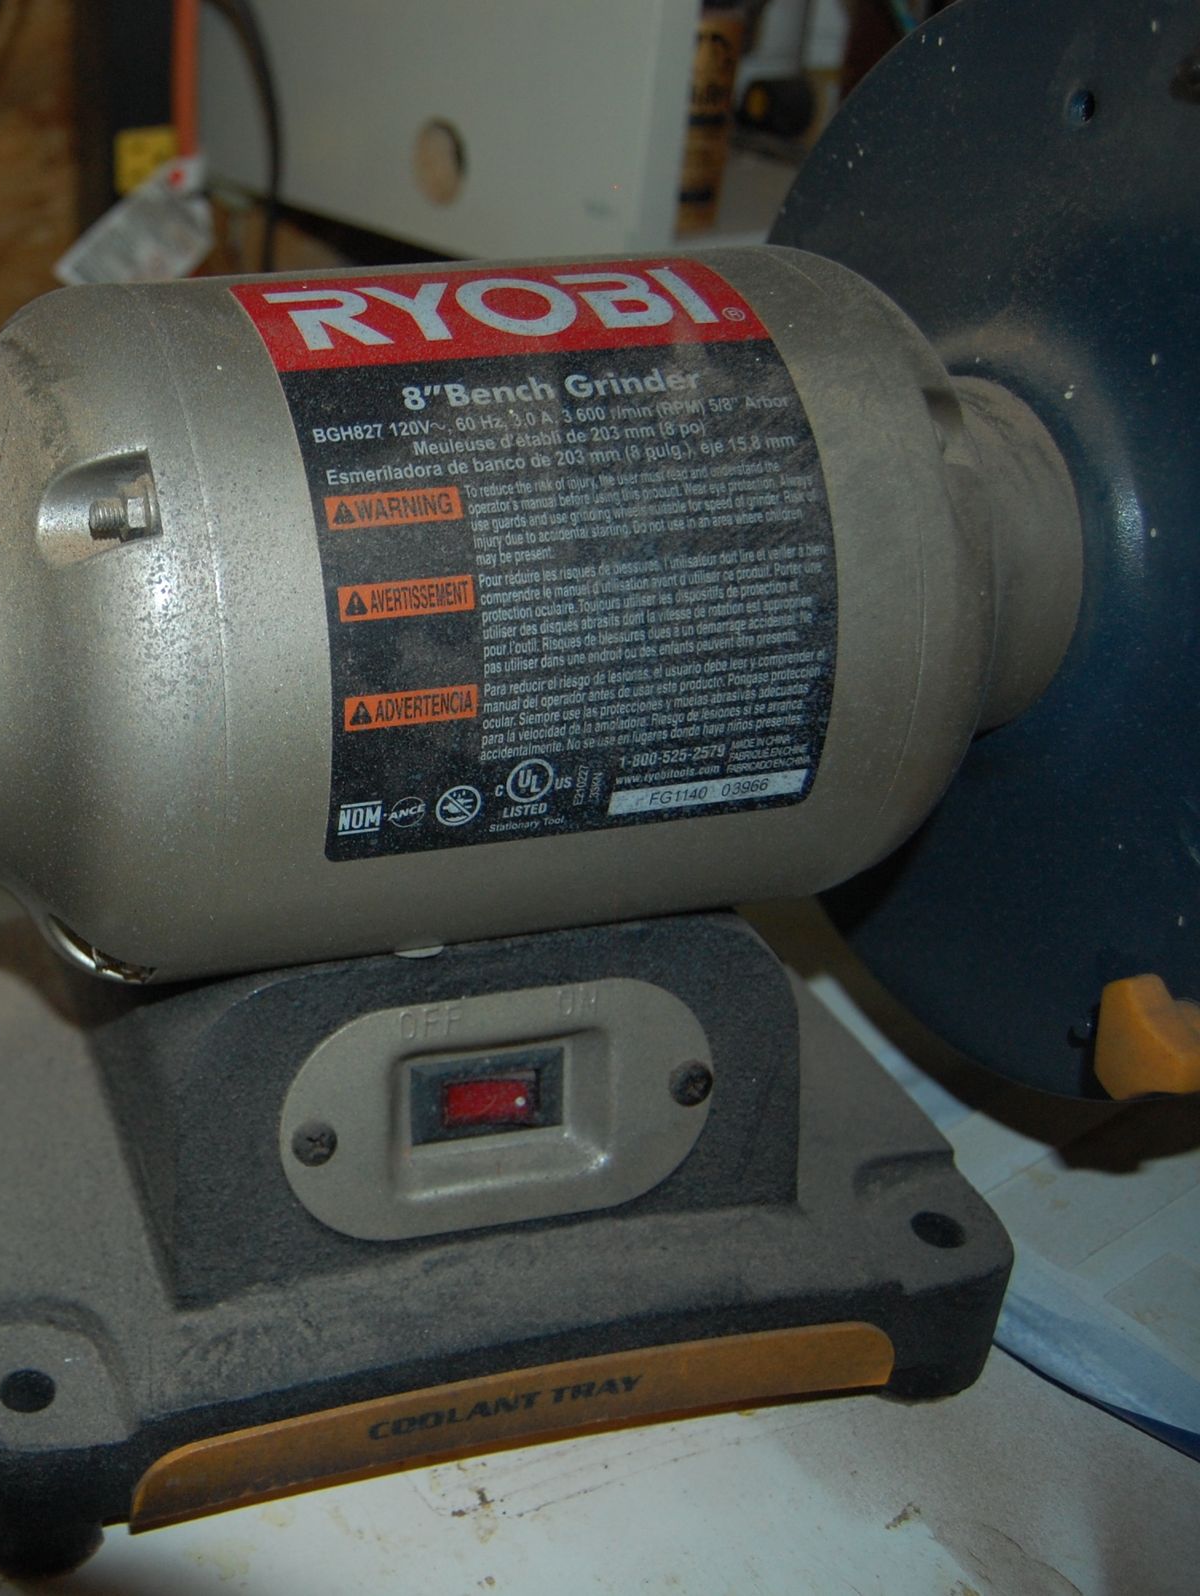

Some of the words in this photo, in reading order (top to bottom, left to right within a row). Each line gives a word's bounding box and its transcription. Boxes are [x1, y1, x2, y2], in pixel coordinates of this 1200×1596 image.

[262, 268, 719, 351] RYOBI
[564, 369, 700, 398] Grinder
[312, 425, 382, 444] BGH827
[455, 417, 475, 431] 60
[511, 412, 535, 427] 3.0
[576, 407, 605, 422] 600
[745, 394, 790, 409] Arbor
[413, 439, 496, 456] Meuleuse
[501, 431, 561, 449] d'établi
[566, 429, 587, 443] de
[589, 426, 620, 441] 203
[624, 427, 654, 438] mm
[659, 422, 675, 440] (8
[680, 419, 705, 438] po)
[326, 464, 443, 485] Esmeriladora
[447, 461, 469, 474] de
[472, 459, 526, 472] banco
[531, 454, 552, 468] de
[555, 450, 586, 466] 203
[589, 451, 622, 463] mm
[624, 446, 641, 464] (8
[701, 440, 724, 458] eje
[765, 437, 797, 449] mm
[464, 486, 477, 498] To
[480, 483, 513, 497] reduce
[516, 481, 532, 493] the
[535, 478, 553, 492] risk
[555, 477, 565, 490] of
[354, 493, 453, 522] WARNING
[521, 496, 557, 510] manual
[559, 494, 589, 506] before
[471, 520, 489, 531] use
[492, 516, 526, 533] guards
[529, 513, 548, 526] and
[551, 513, 567, 524] use
[473, 536, 502, 552] injury
[505, 534, 524, 545] due
[526, 532, 537, 543] to
[649, 519, 664, 532] not
[687, 517, 696, 529] in
[698, 517, 710, 528] an
[712, 515, 733, 526] area
[476, 554, 498, 567] may
[500, 552, 513, 563] be
[479, 574, 502, 587] Pour
[543, 569, 557, 581] les
[560, 567, 595, 582] risques
[370, 581, 468, 613] AVERTISSEMENT
[481, 588, 540, 607] comprendre
[542, 586, 552, 599] le
[555, 582, 589, 598] manuel
[482, 606, 532, 626] protection
[534, 602, 577, 617] oculaire.
[578, 598, 621, 615] Toujours
[483, 626, 517, 640] utiliser
[520, 623, 538, 636] des
[540, 620, 579, 636] disques
[581, 614, 620, 629] abrasifs
[622, 611, 645, 625] dont
[647, 610, 656, 623] la
[658, 608, 692, 621] vitesse
[694, 605, 706, 617] de
[483, 645, 506, 661] pour
[542, 637, 581, 653] Risques
[584, 633, 597, 646] de
[598, 630, 646, 645] blessures
[648, 627, 672, 640] dues
[484, 662, 502, 677] pas
[505, 657, 539, 671] utiliser
[541, 655, 566, 667] dans
[568, 653, 586, 664] une
[588, 647, 622, 662] endroit
[624, 648, 637, 659] ou
[639, 644, 657, 657] des
[659, 639, 695, 655] enfants
[483, 684, 506, 697] Para
[509, 678, 546, 694] reducir
[547, 676, 557, 690] el
[559, 675, 591, 690] riesgo
[593, 672, 606, 685] de
[483, 696, 521, 713] manual
[522, 694, 539, 708] del
[541, 690, 587, 710] operador
[588, 687, 616, 701] antes
[617, 685, 631, 698] de
[633, 684, 655, 696] usar
[375, 691, 474, 723] ADVERTENCIA
[482, 715, 516, 730] ocular.
[518, 711, 561, 727] Siempre
[563, 709, 581, 721] use
[582, 706, 599, 718] las
[480, 740, 564, 760] accidentalmente.
[566, 737, 581, 750] No
[583, 737, 596, 748] se
[481, 733, 504, 749] para
[506, 730, 516, 742] la
[519, 723, 566, 741] velocidad
[569, 722, 580, 735] de
[583, 721, 592, 734] la
[619, 743, 726, 769] 1-800-525-2579
[649, 785, 708, 805] FG1140
[720, 778, 770, 798] 03966
[338, 805, 382, 831] NOM
[488, 820, 540, 833] Stationary
[543, 815, 565, 826] Tool
[502, 802, 548, 819] LISTED
[400, 1005, 462, 1040] OFF
[367, 1391, 542, 1441] COOLANT
[550, 1374, 643, 1404] TRAY
